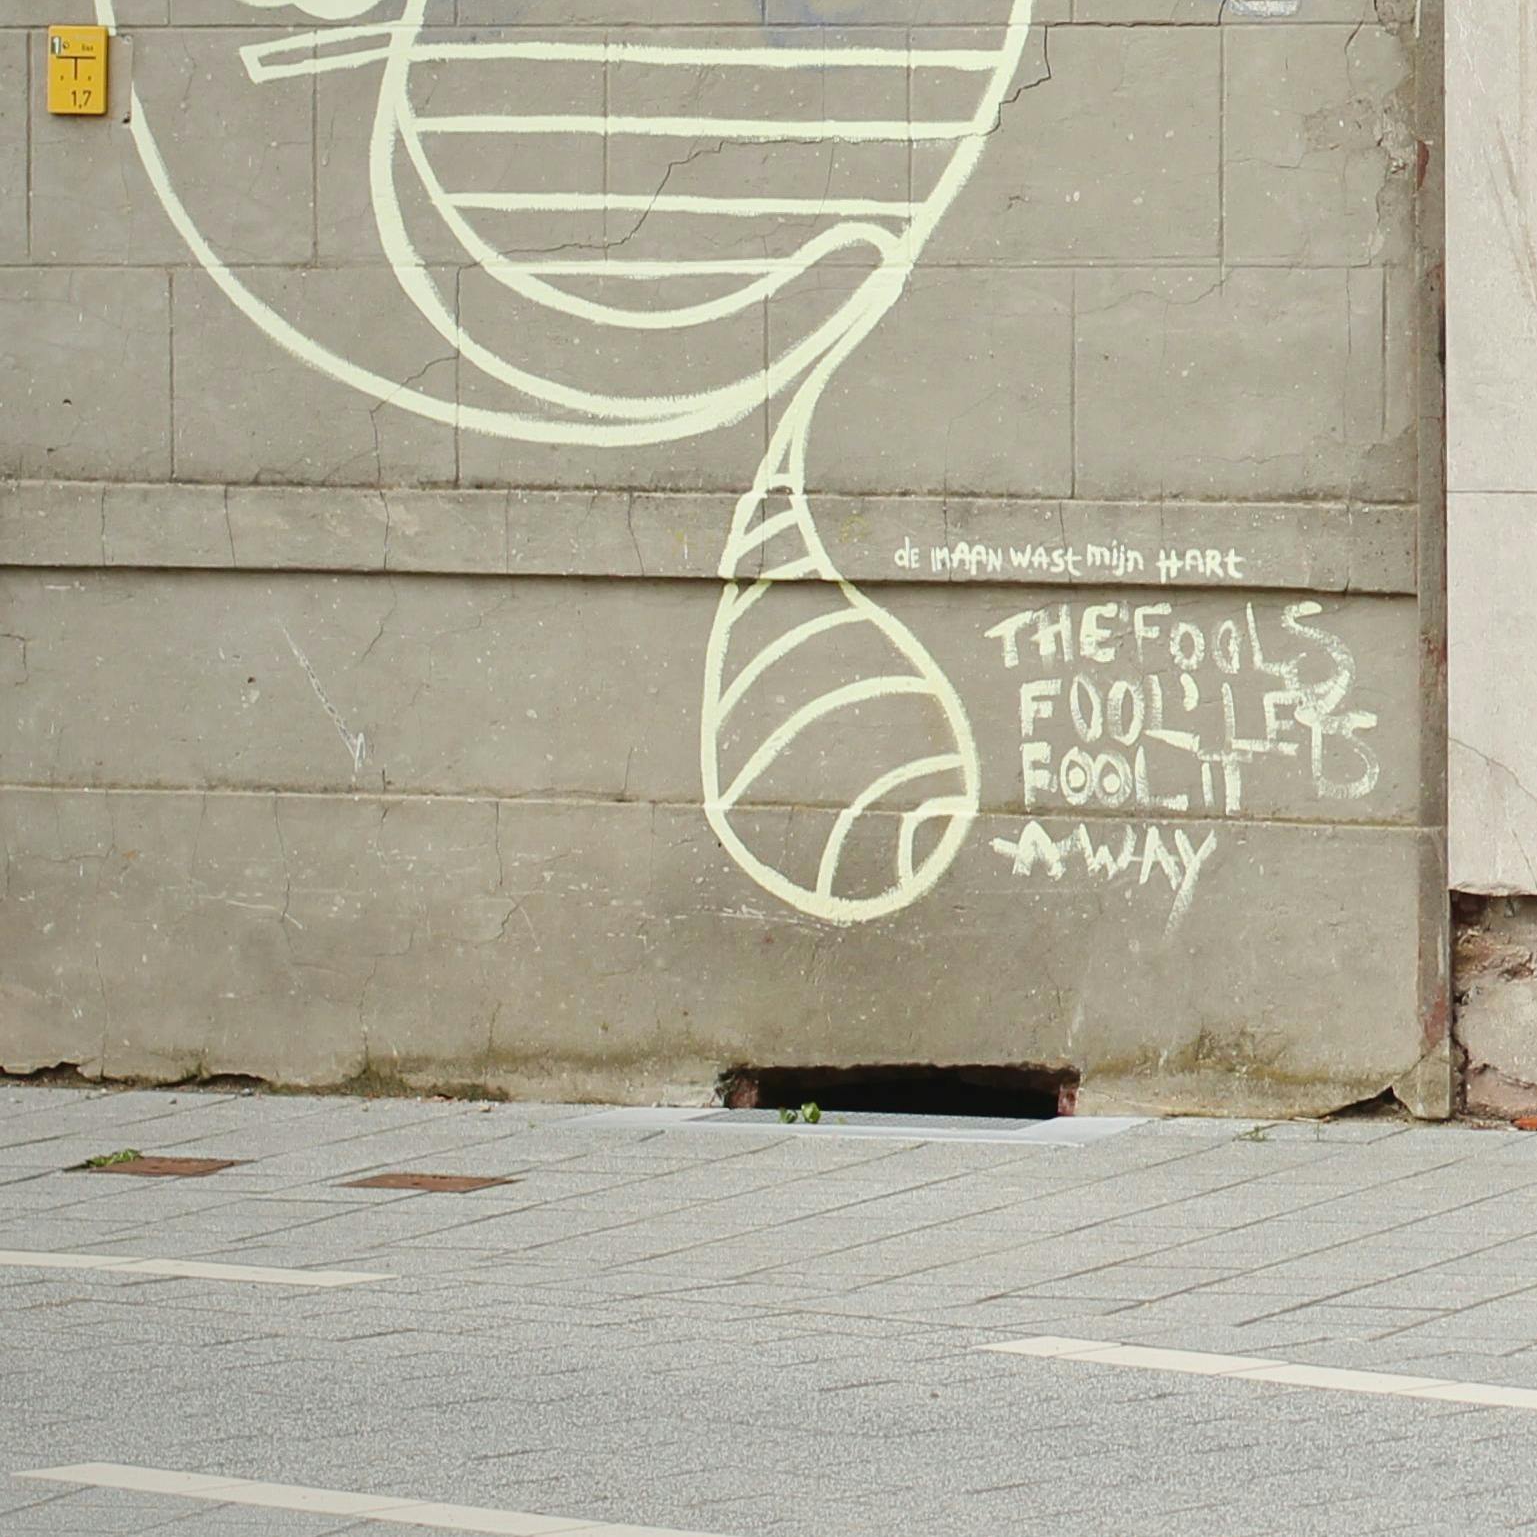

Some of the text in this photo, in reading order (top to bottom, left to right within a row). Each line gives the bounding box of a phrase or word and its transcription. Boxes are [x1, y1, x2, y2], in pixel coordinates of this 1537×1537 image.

[1086, 539, 1144, 577] mijn
[984, 601, 1356, 721] THE FOOLS
[1021, 741, 1189, 812] FOOL
[988, 820, 1217, 941] AWAY
